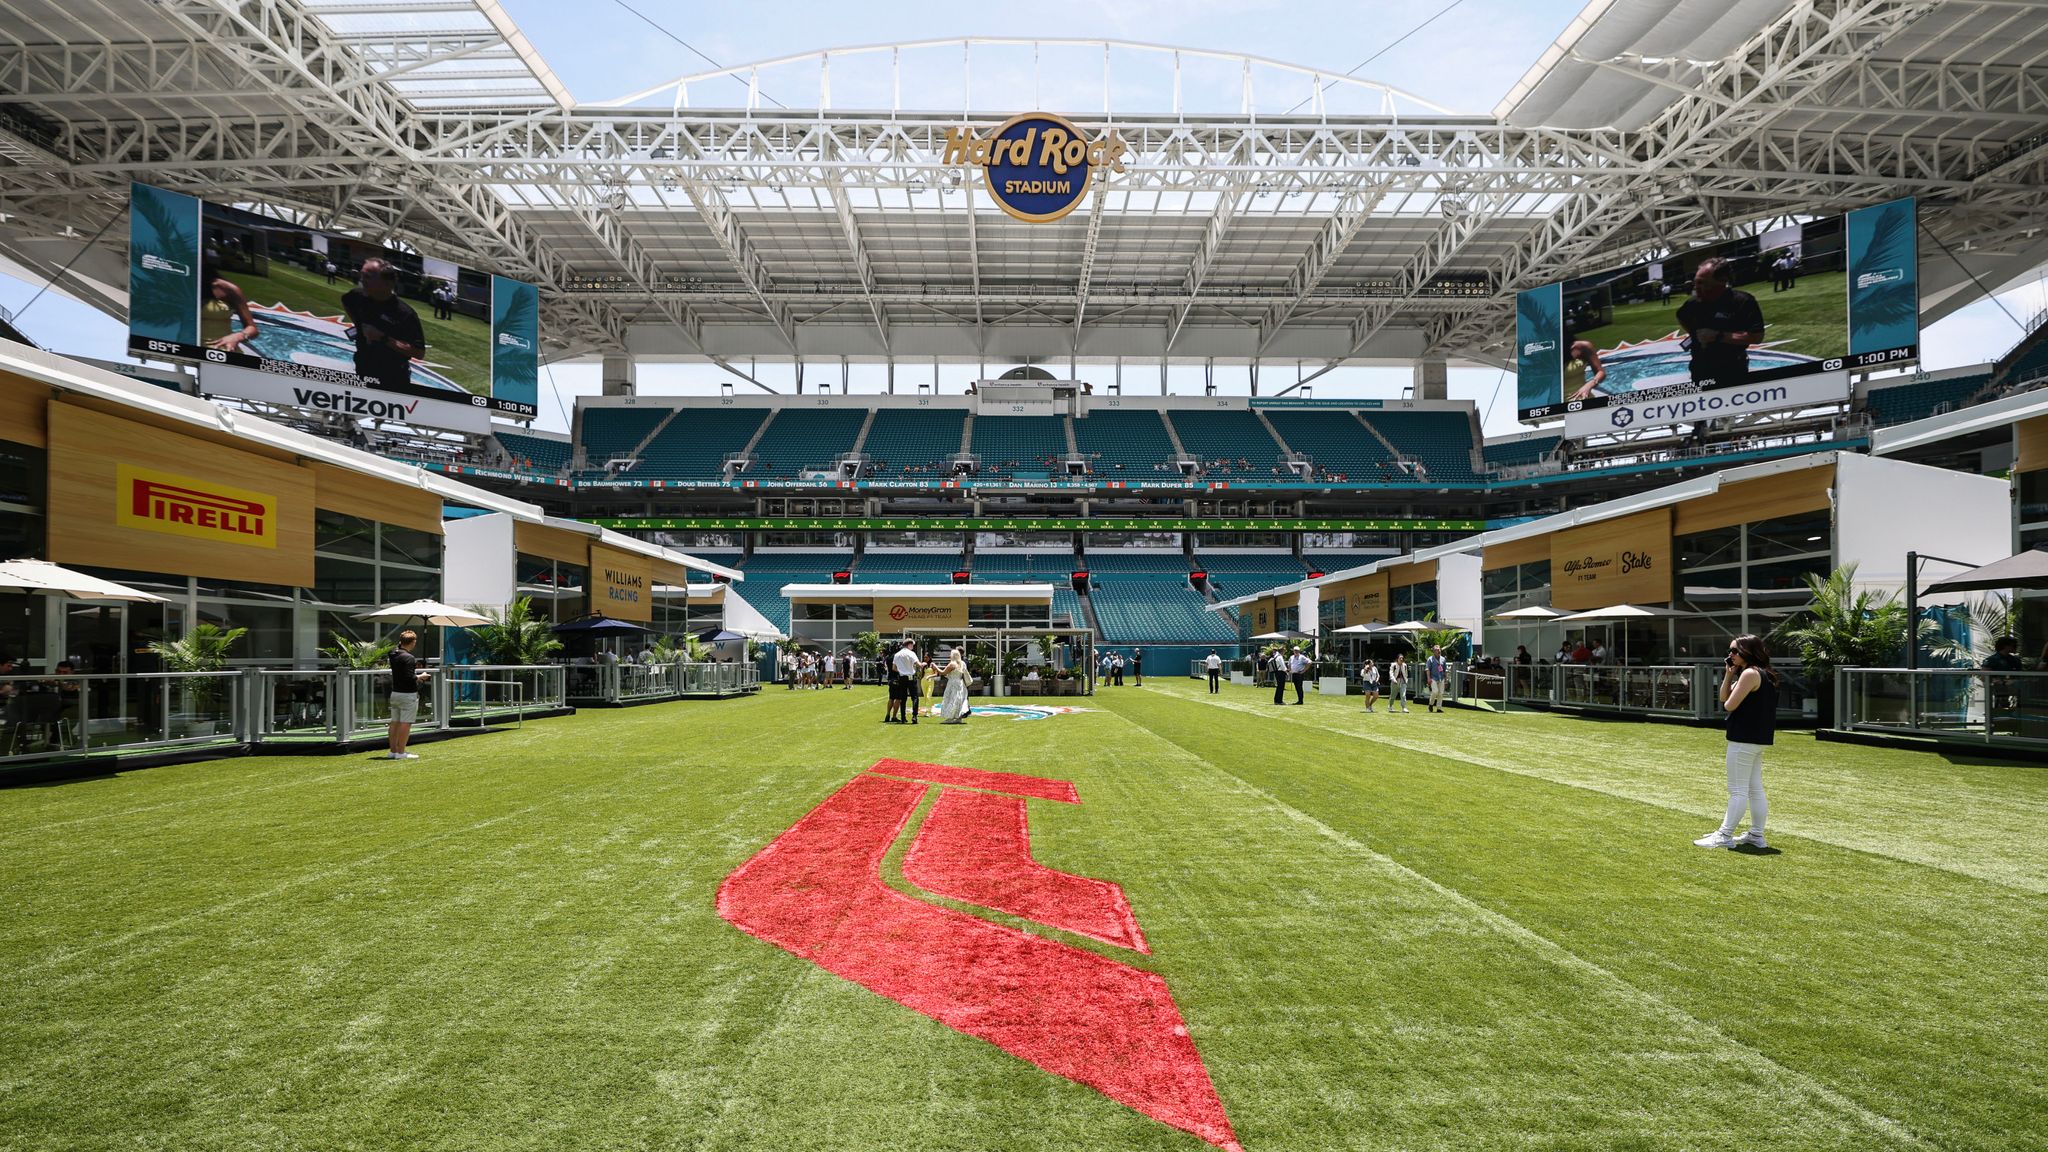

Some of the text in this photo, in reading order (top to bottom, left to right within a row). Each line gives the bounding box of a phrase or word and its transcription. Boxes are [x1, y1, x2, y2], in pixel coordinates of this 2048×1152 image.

[943, 127, 1127, 174] Hard Rock
[1005, 180, 1071, 194] STADIUM
[148, 340, 181, 354] 85°F
[208, 351, 225, 361] CC
[1858, 348, 1908, 365] 1:00 PM
[114, 363, 136, 373] 324
[260, 358, 299, 371] THERE'S
[363, 376, 380, 385] 60%
[1824, 360, 1841, 369] CC
[260, 364, 368, 388] DEPENDS HOW POSITIVE
[1699, 378, 1716, 387] 60%
[1910, 372, 1931, 383] 340
[293, 387, 405, 420] verizon
[473, 397, 486, 405] CC
[1607, 386, 1702, 407] DEPENDS HOW POSITIVE
[1643, 387, 1786, 419] crypto.com
[498, 401, 532, 414] 1:00 PM
[1529, 407, 1550, 417] 85°F
[1569, 402, 1581, 410] CC
[1519, 432, 1532, 440] 337
[475, 469, 545, 484] RICHMOND WEBB 78
[132, 478, 265, 536] PIRELLI
[1564, 551, 1652, 576] Alfa Romeo Stake
[604, 568, 642, 589] WILLIAMS
[1584, 573, 1597, 581] TEAM
[609, 587, 639, 603] RACING
[908, 606, 952, 614] MoneyGram
